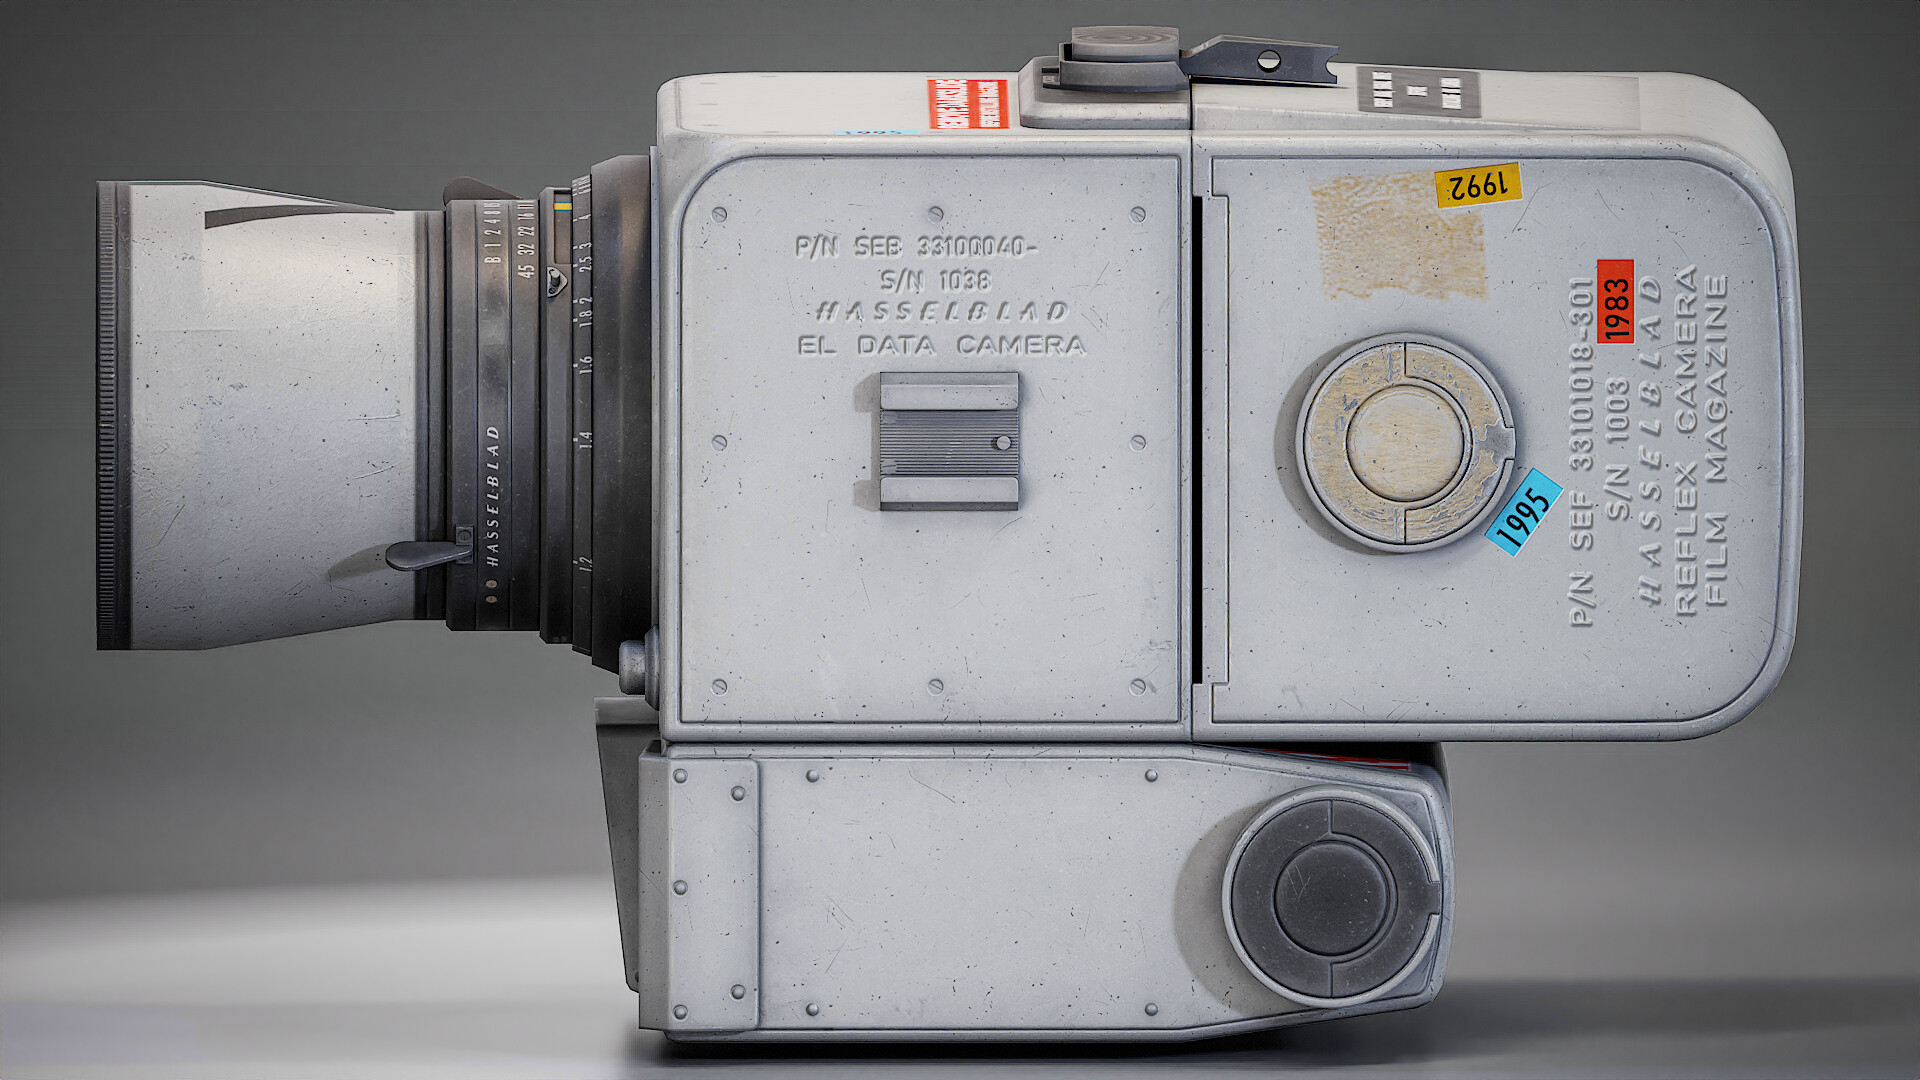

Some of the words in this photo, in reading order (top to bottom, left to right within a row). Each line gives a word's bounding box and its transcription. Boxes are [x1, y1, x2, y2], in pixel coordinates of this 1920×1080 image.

[1449, 171, 1508, 200] 1992
[517, 212, 535, 220] 16
[517, 226, 535, 236] 22
[517, 243, 535, 255] 32
[579, 242, 593, 250] 3
[795, 234, 839, 260] P/N
[854, 235, 903, 259] SEB
[917, 234, 1039, 260] 33100040-
[517, 264, 535, 279] 45
[579, 256, 593, 273] 2.5
[880, 268, 926, 295] S/N
[939, 269, 992, 292] 1038
[579, 310, 593, 327] 1.8
[814, 300, 1070, 323] HASSELBLAD
[1604, 278, 1630, 340] 1983
[797, 334, 838, 357] EL
[856, 334, 937, 357] DATA
[956, 334, 1088, 357] CAMERA
[1674, 263, 1698, 434] CAMERA
[579, 356, 593, 374] 1.6
[1569, 277, 1594, 471] 33101018-301
[1704, 274, 1728, 483] MAGAZINE
[1605, 377, 1630, 444] 1003
[579, 431, 593, 449] 1.4
[1639, 275, 1662, 607] HASSELBLAD
[486, 426, 499, 567] HASSELBLAD
[1603, 464, 1633, 521] S/N
[1496, 487, 1549, 548] 1995
[1569, 490, 1594, 551] SEF
[1674, 461, 1698, 616] REFLEX
[579, 556, 593, 572] 1.2
[1704, 512, 1728, 607] FILM
[1567, 571, 1597, 627] P/N
